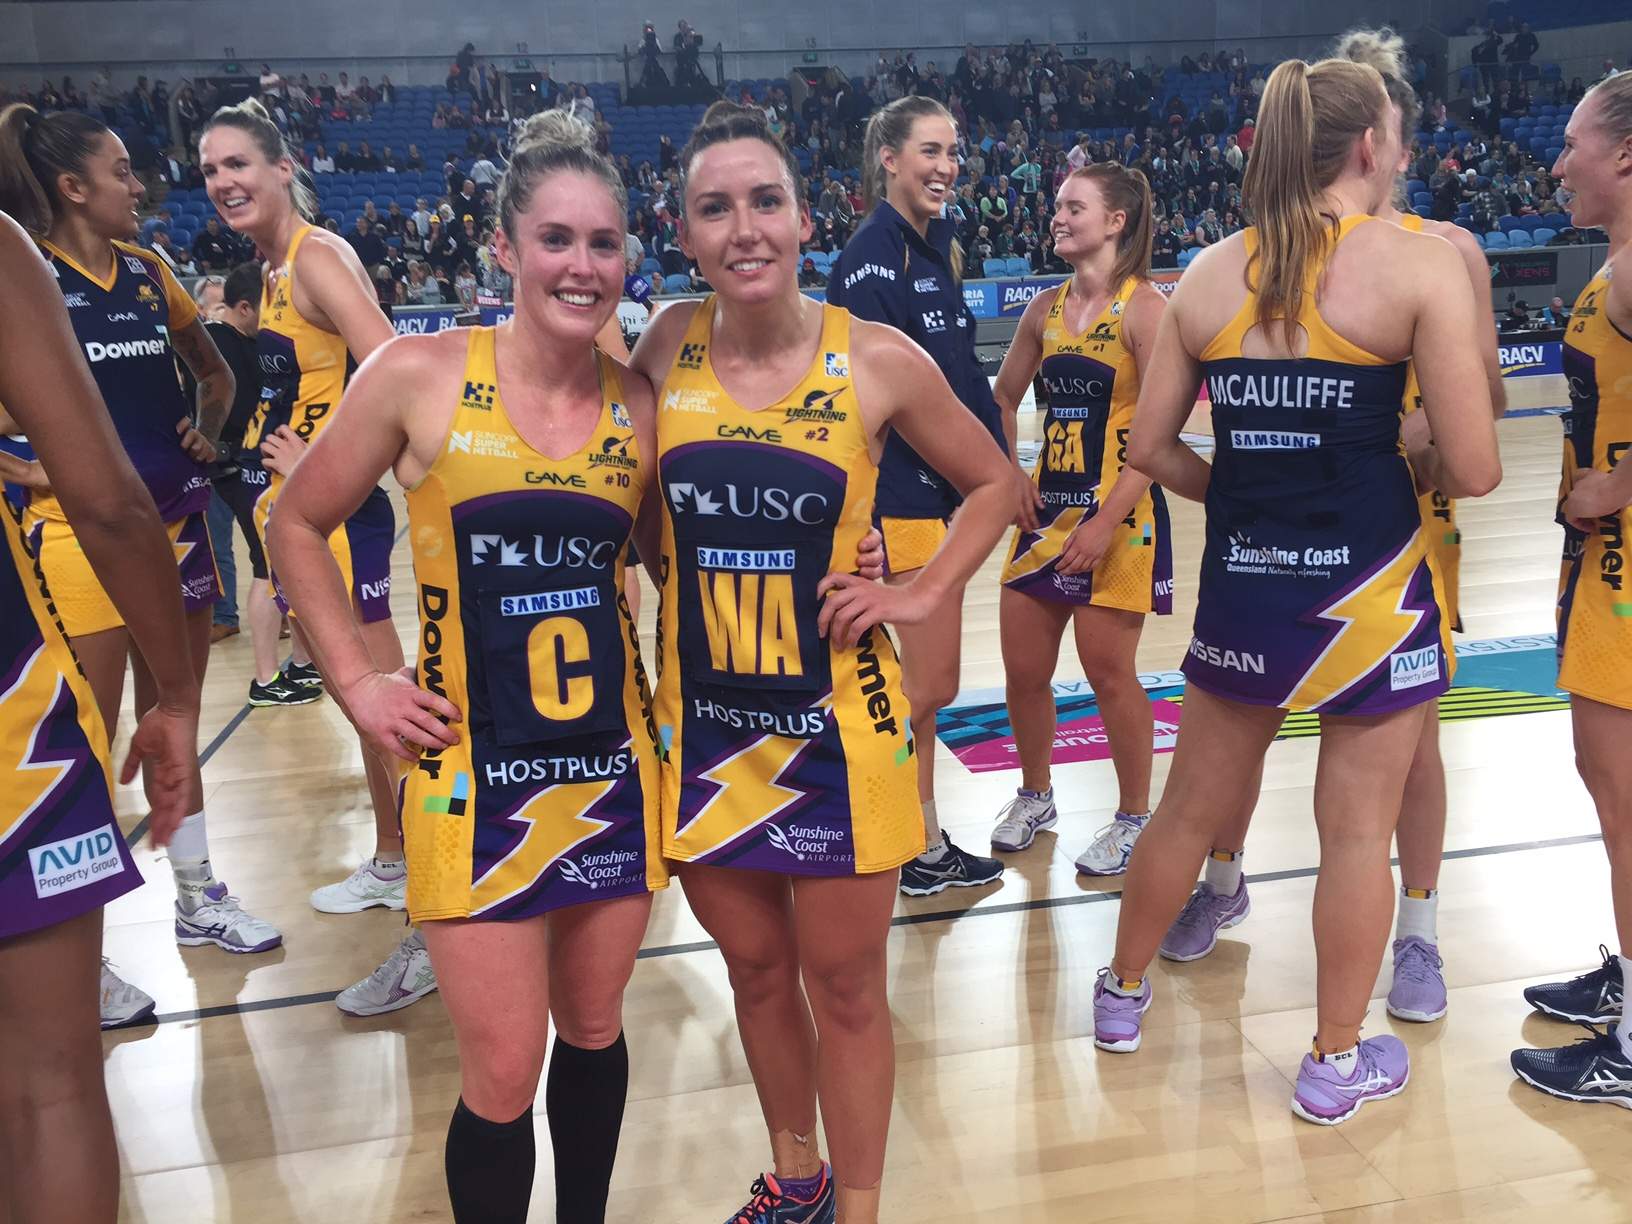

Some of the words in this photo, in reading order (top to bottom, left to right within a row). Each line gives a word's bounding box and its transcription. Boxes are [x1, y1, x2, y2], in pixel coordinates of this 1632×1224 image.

[844, 263, 896, 289] SAMSUNG
[1004, 286, 1040, 302] RACV
[84, 339, 166, 362] Downer
[1499, 345, 1544, 365] RACV
[825, 366, 848, 377] USC
[1058, 377, 1104, 397] USC
[1210, 374, 1355, 408] MCAULIFFE
[785, 407, 847, 422] LIGHTNING
[1053, 408, 1087, 417] MSUNG
[717, 424, 782, 443] GAME
[804, 427, 829, 442] #2
[1234, 432, 1317, 448] SAMSUNG
[1047, 420, 1086, 473] GA
[588, 453, 638, 469] LIGHTNING
[241, 467, 268, 485] PLUS
[525, 471, 587, 488] GAME
[605, 472, 630, 488] #10
[725, 483, 827, 525] USC
[533, 534, 616, 570] USC
[699, 549, 794, 568] SAMSUNG
[1228, 545, 1298, 565] Sunshine
[1303, 546, 1350, 566] Coast
[1226, 563, 1267, 574] Queensland
[361, 577, 391, 600] NIS
[1155, 578, 1173, 597] NIS
[503, 588, 599, 615] SAMSUNG
[697, 570, 804, 676] WA
[527, 616, 595, 722] C
[1393, 649, 1437, 674] AVID
[420, 583, 449, 780] Dowr
[1393, 673, 1421, 685] Property
[694, 699, 824, 737] HOSTPLUS
[485, 753, 628, 786] HOSTPLUS
[788, 824, 844, 841] Sunshine
[37, 832, 113, 876] AVID
[795, 839, 829, 853] Coast
[581, 850, 639, 868] Sunshine
[806, 854, 853, 862] AIRPORT
[39, 866, 90, 890] Property
[91, 857, 119, 875] Group
[588, 864, 624, 880] Coast
[600, 873, 643, 888] AIRPORT
